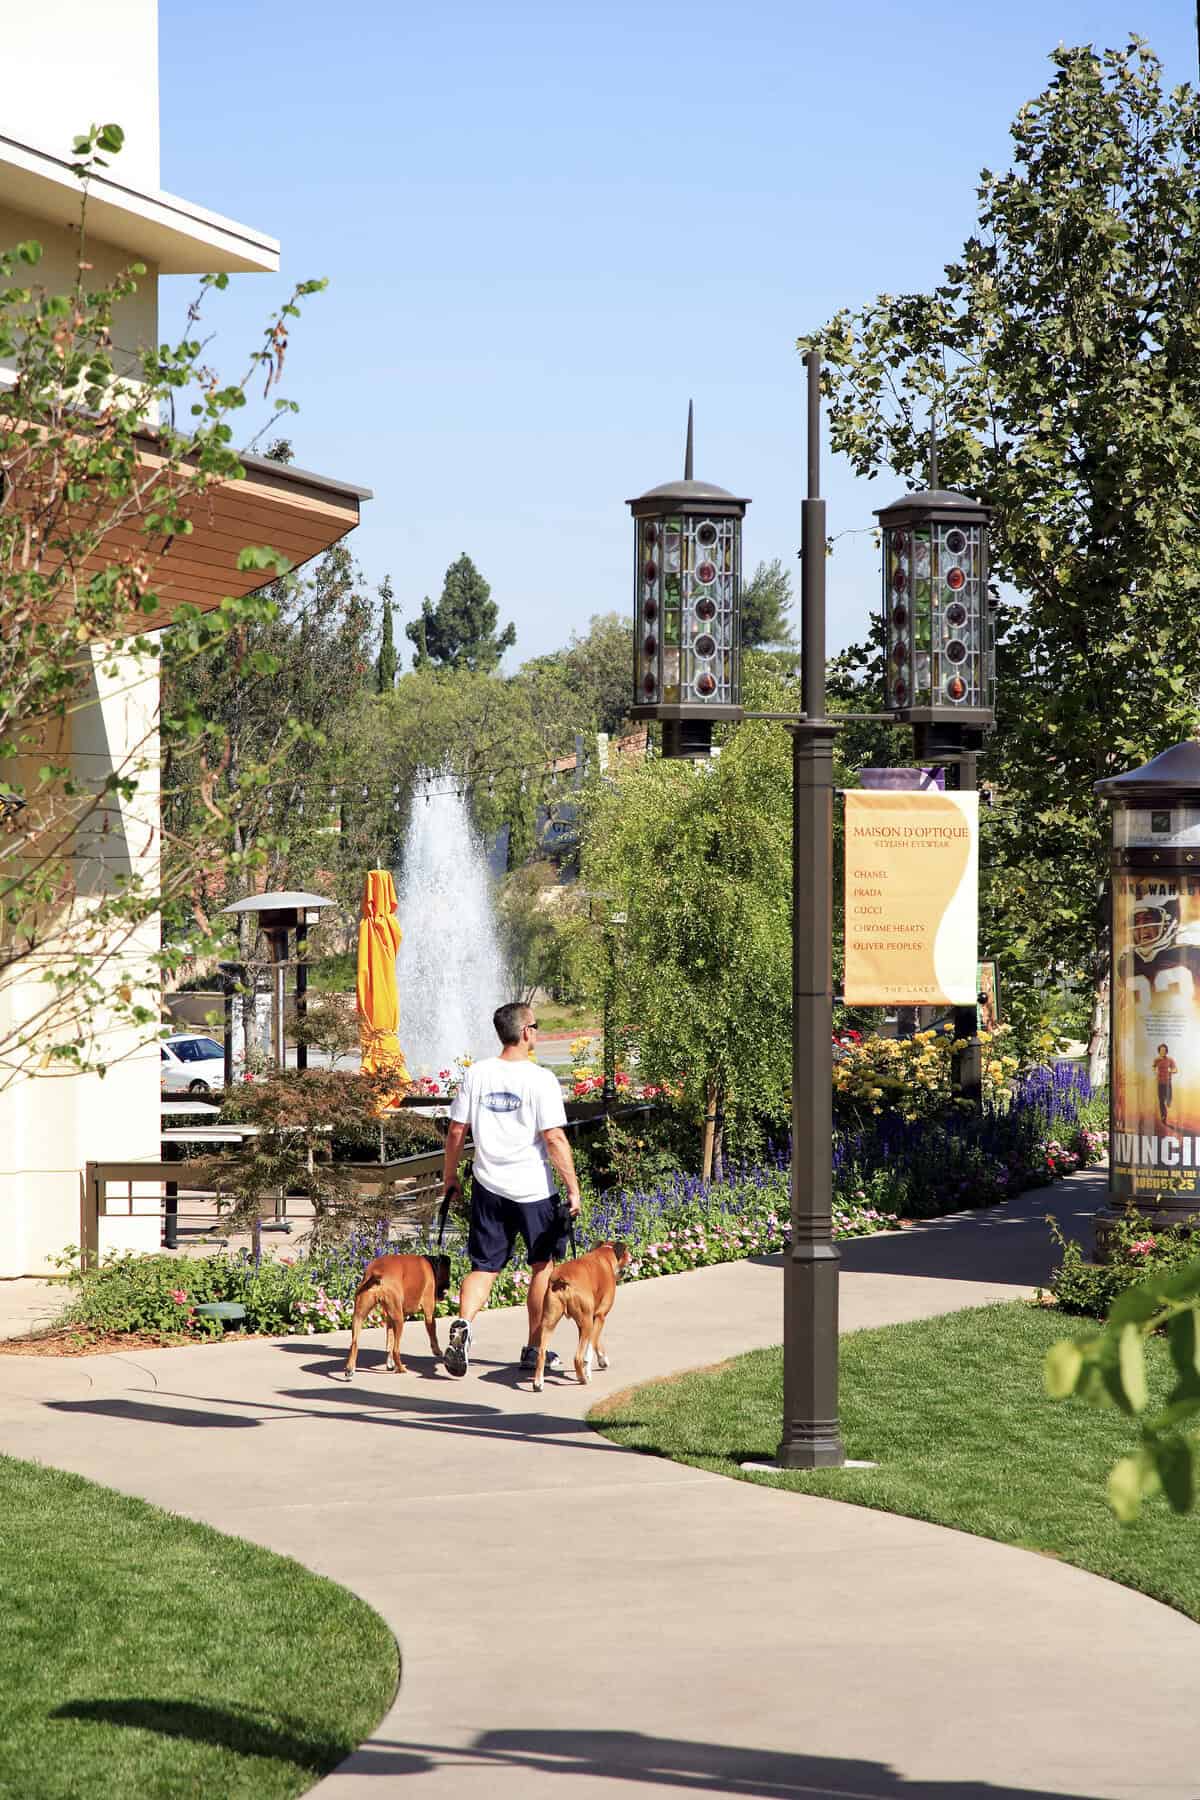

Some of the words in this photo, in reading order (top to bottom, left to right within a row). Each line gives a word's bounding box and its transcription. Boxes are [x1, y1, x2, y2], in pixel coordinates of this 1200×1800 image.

[853, 826, 900, 838] MAISON
[903, 826, 969, 840] D'OPTIQUE
[874, 840, 909, 849] STYLISH
[911, 840, 951, 849] EYEWEAR
[853, 870, 889, 879] CHANEL
[853, 887, 882, 897] PRADA
[853, 905, 883, 914] GUCCI
[853, 923, 892, 933] CHROME
[893, 923, 925, 933] HEARTS
[853, 942, 886, 951] OLIVER
[886, 942, 923, 951] PEOPLES
